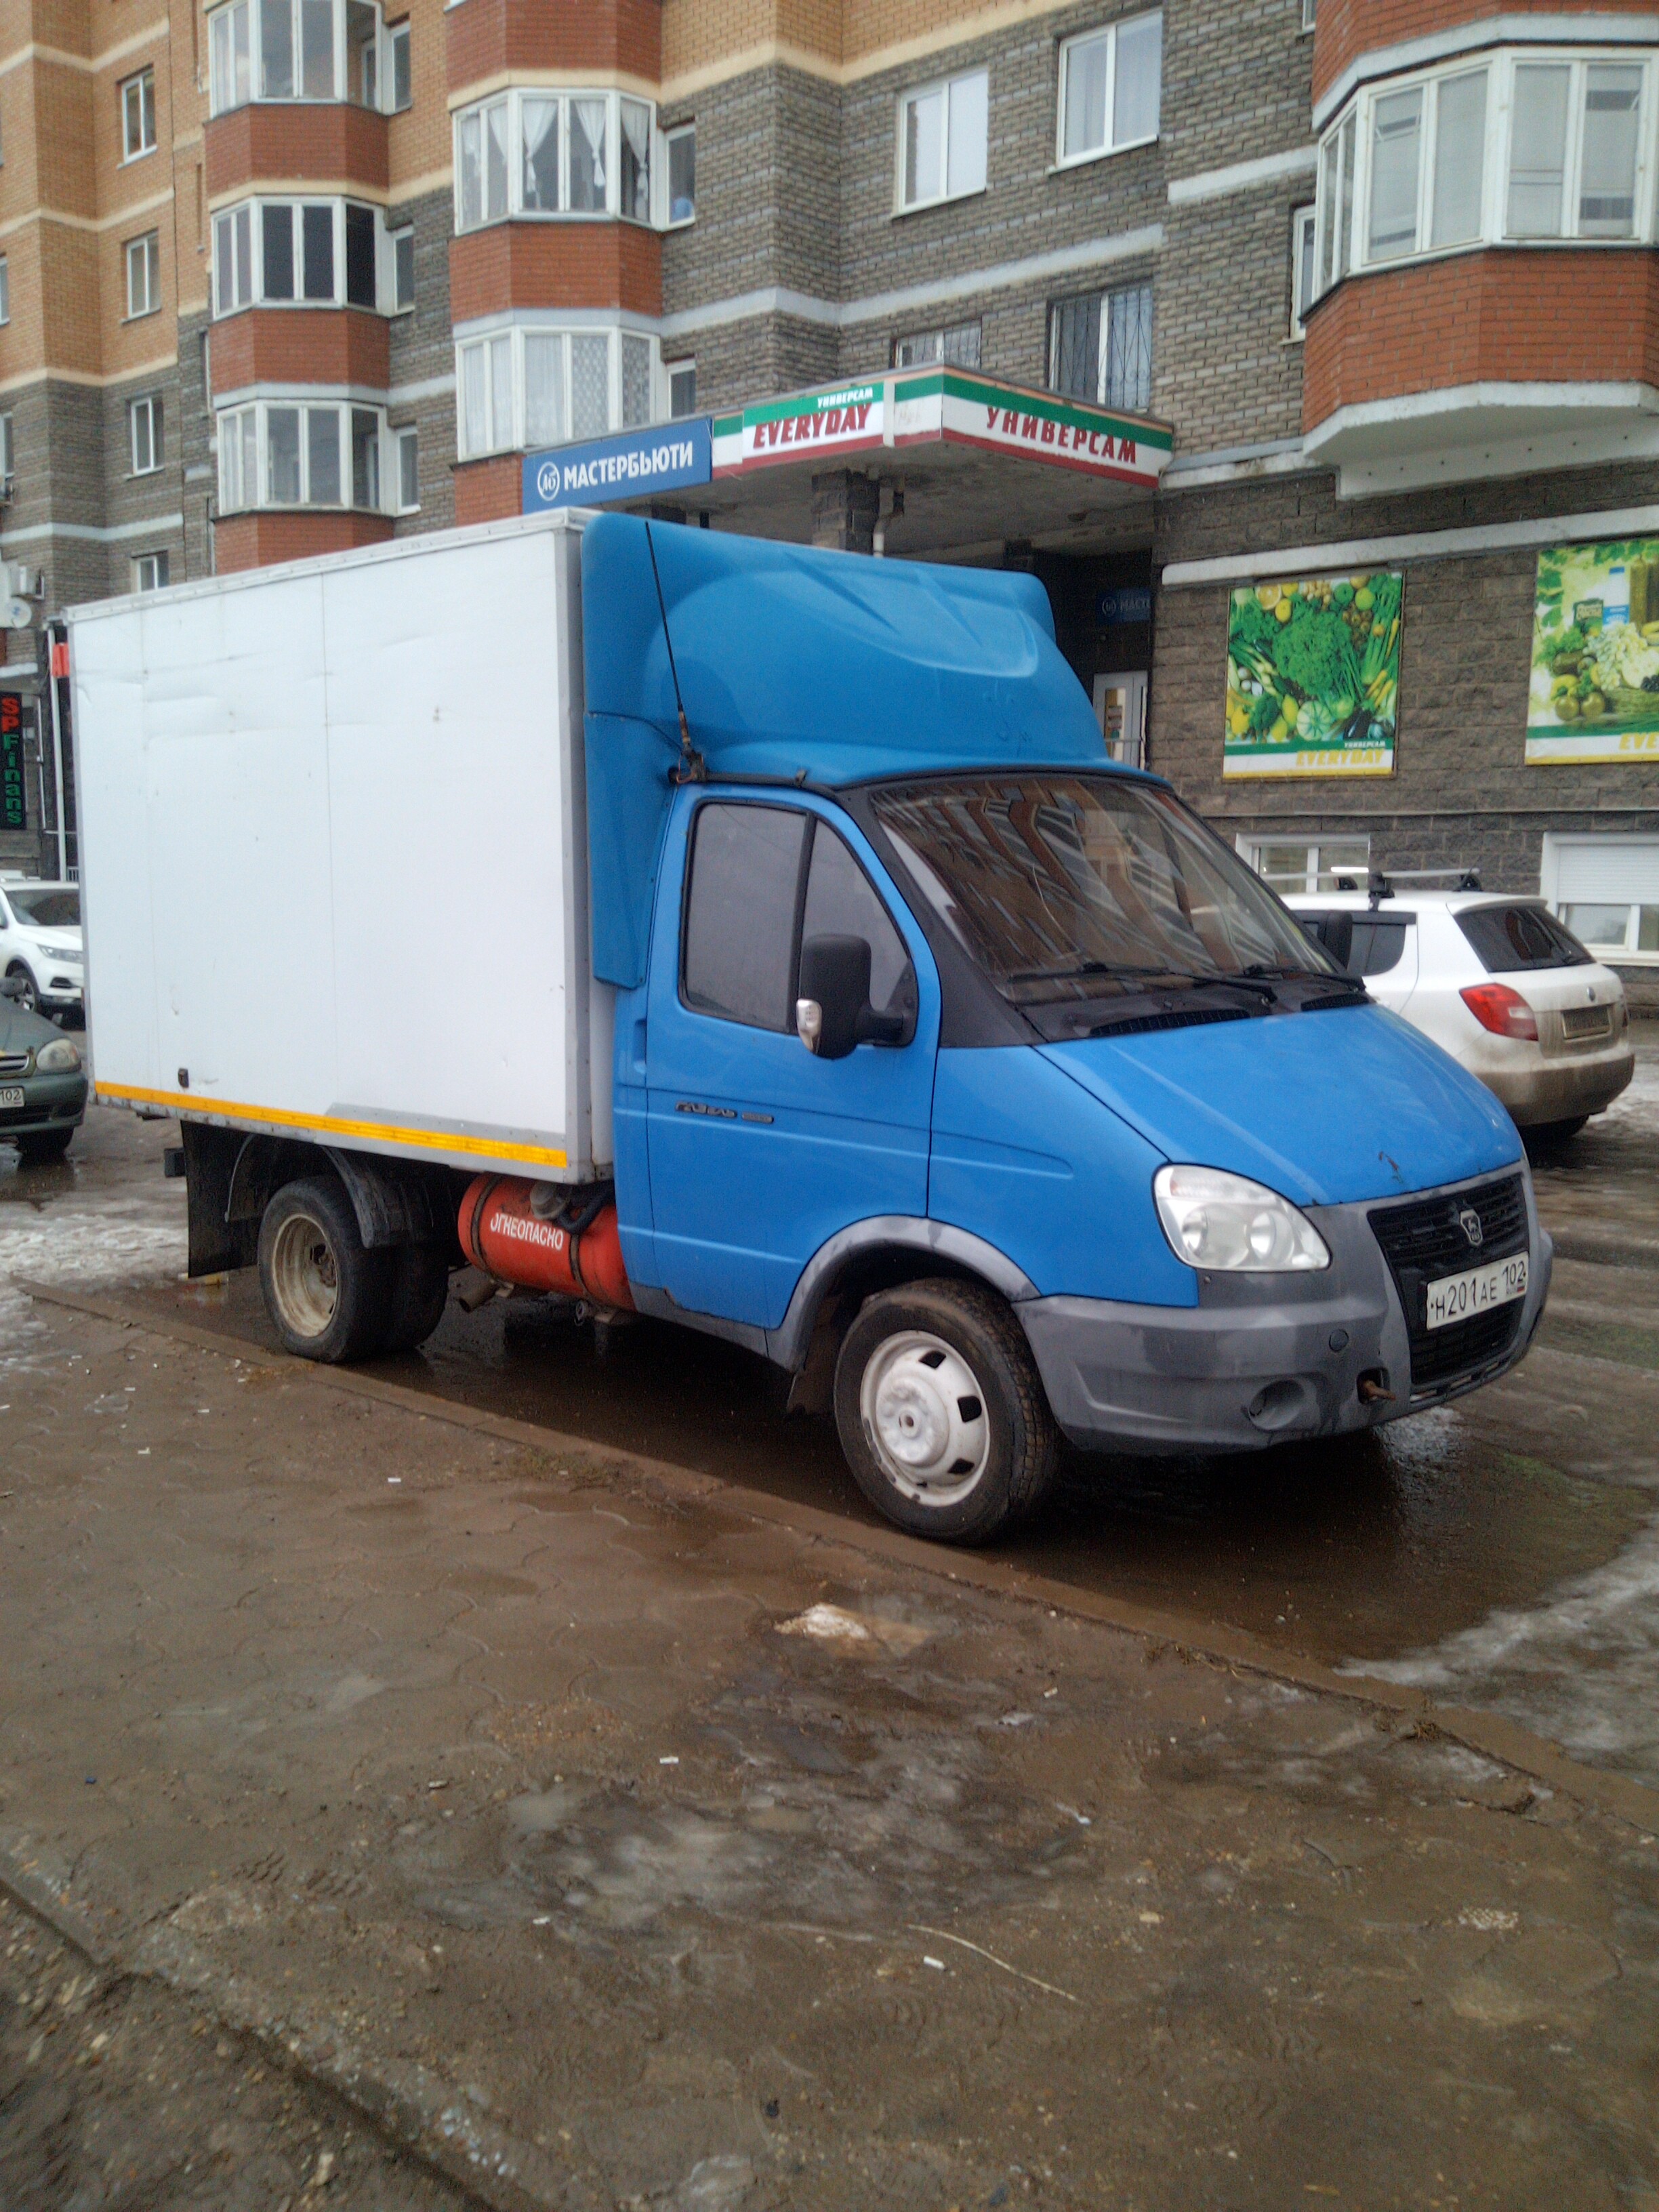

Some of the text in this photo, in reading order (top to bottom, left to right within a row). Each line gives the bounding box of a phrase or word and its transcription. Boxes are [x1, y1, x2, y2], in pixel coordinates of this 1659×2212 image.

[818, 386, 873, 409] УНИВЕРСАМ
[753, 403, 872, 449] EVERYDAY
[987, 407, 1137, 464] УНИВЕРСАМ
[564, 441, 693, 491] МАСТЕРБЬЮТИ
[1296, 748, 1385, 766] EVERYDAY
[491, 1212, 563, 1251] ОГНЕОПАСНО
[1502, 1261, 1525, 1286] 102
